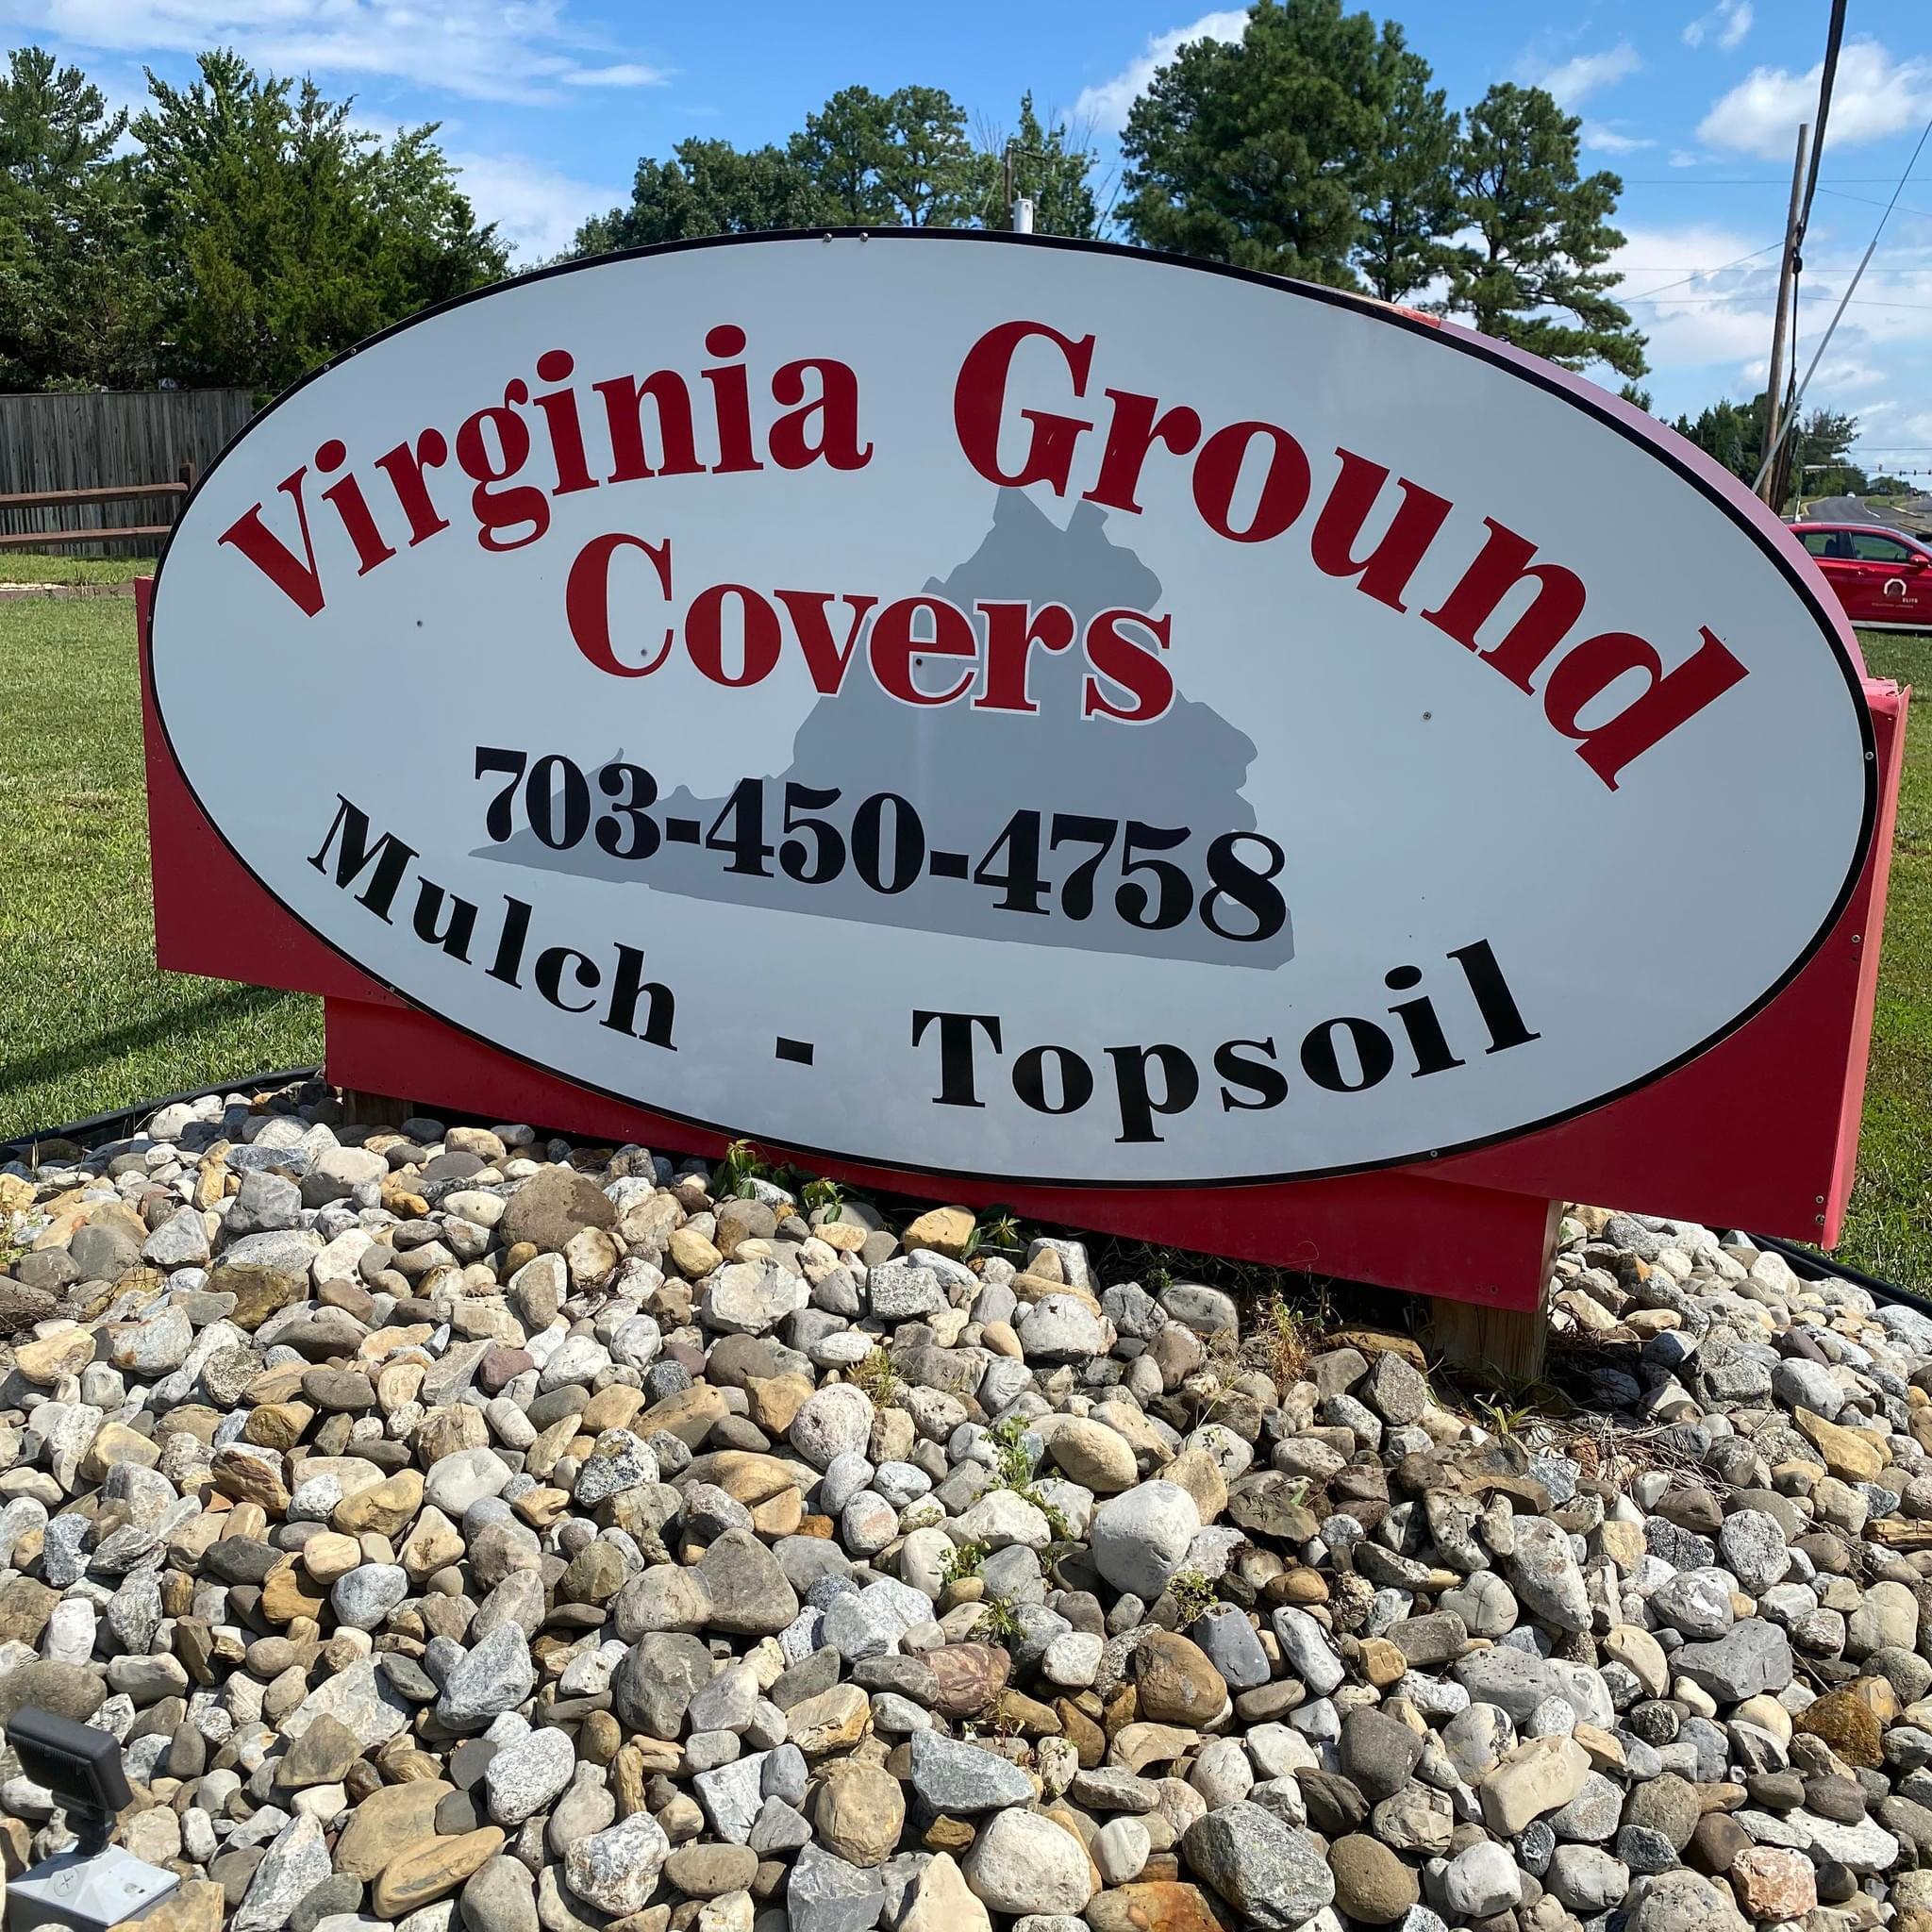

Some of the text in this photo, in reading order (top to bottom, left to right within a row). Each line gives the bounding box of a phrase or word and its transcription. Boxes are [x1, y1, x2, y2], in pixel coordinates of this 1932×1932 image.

[220, 321, 1749, 791] Virginia Ground
[566, 533, 1174, 721] Covers
[307, 792, 678, 1052] Mulch
[911, 938, 1541, 1143] Topsoil
[475, 745, 1287, 942] 703-450-4758
